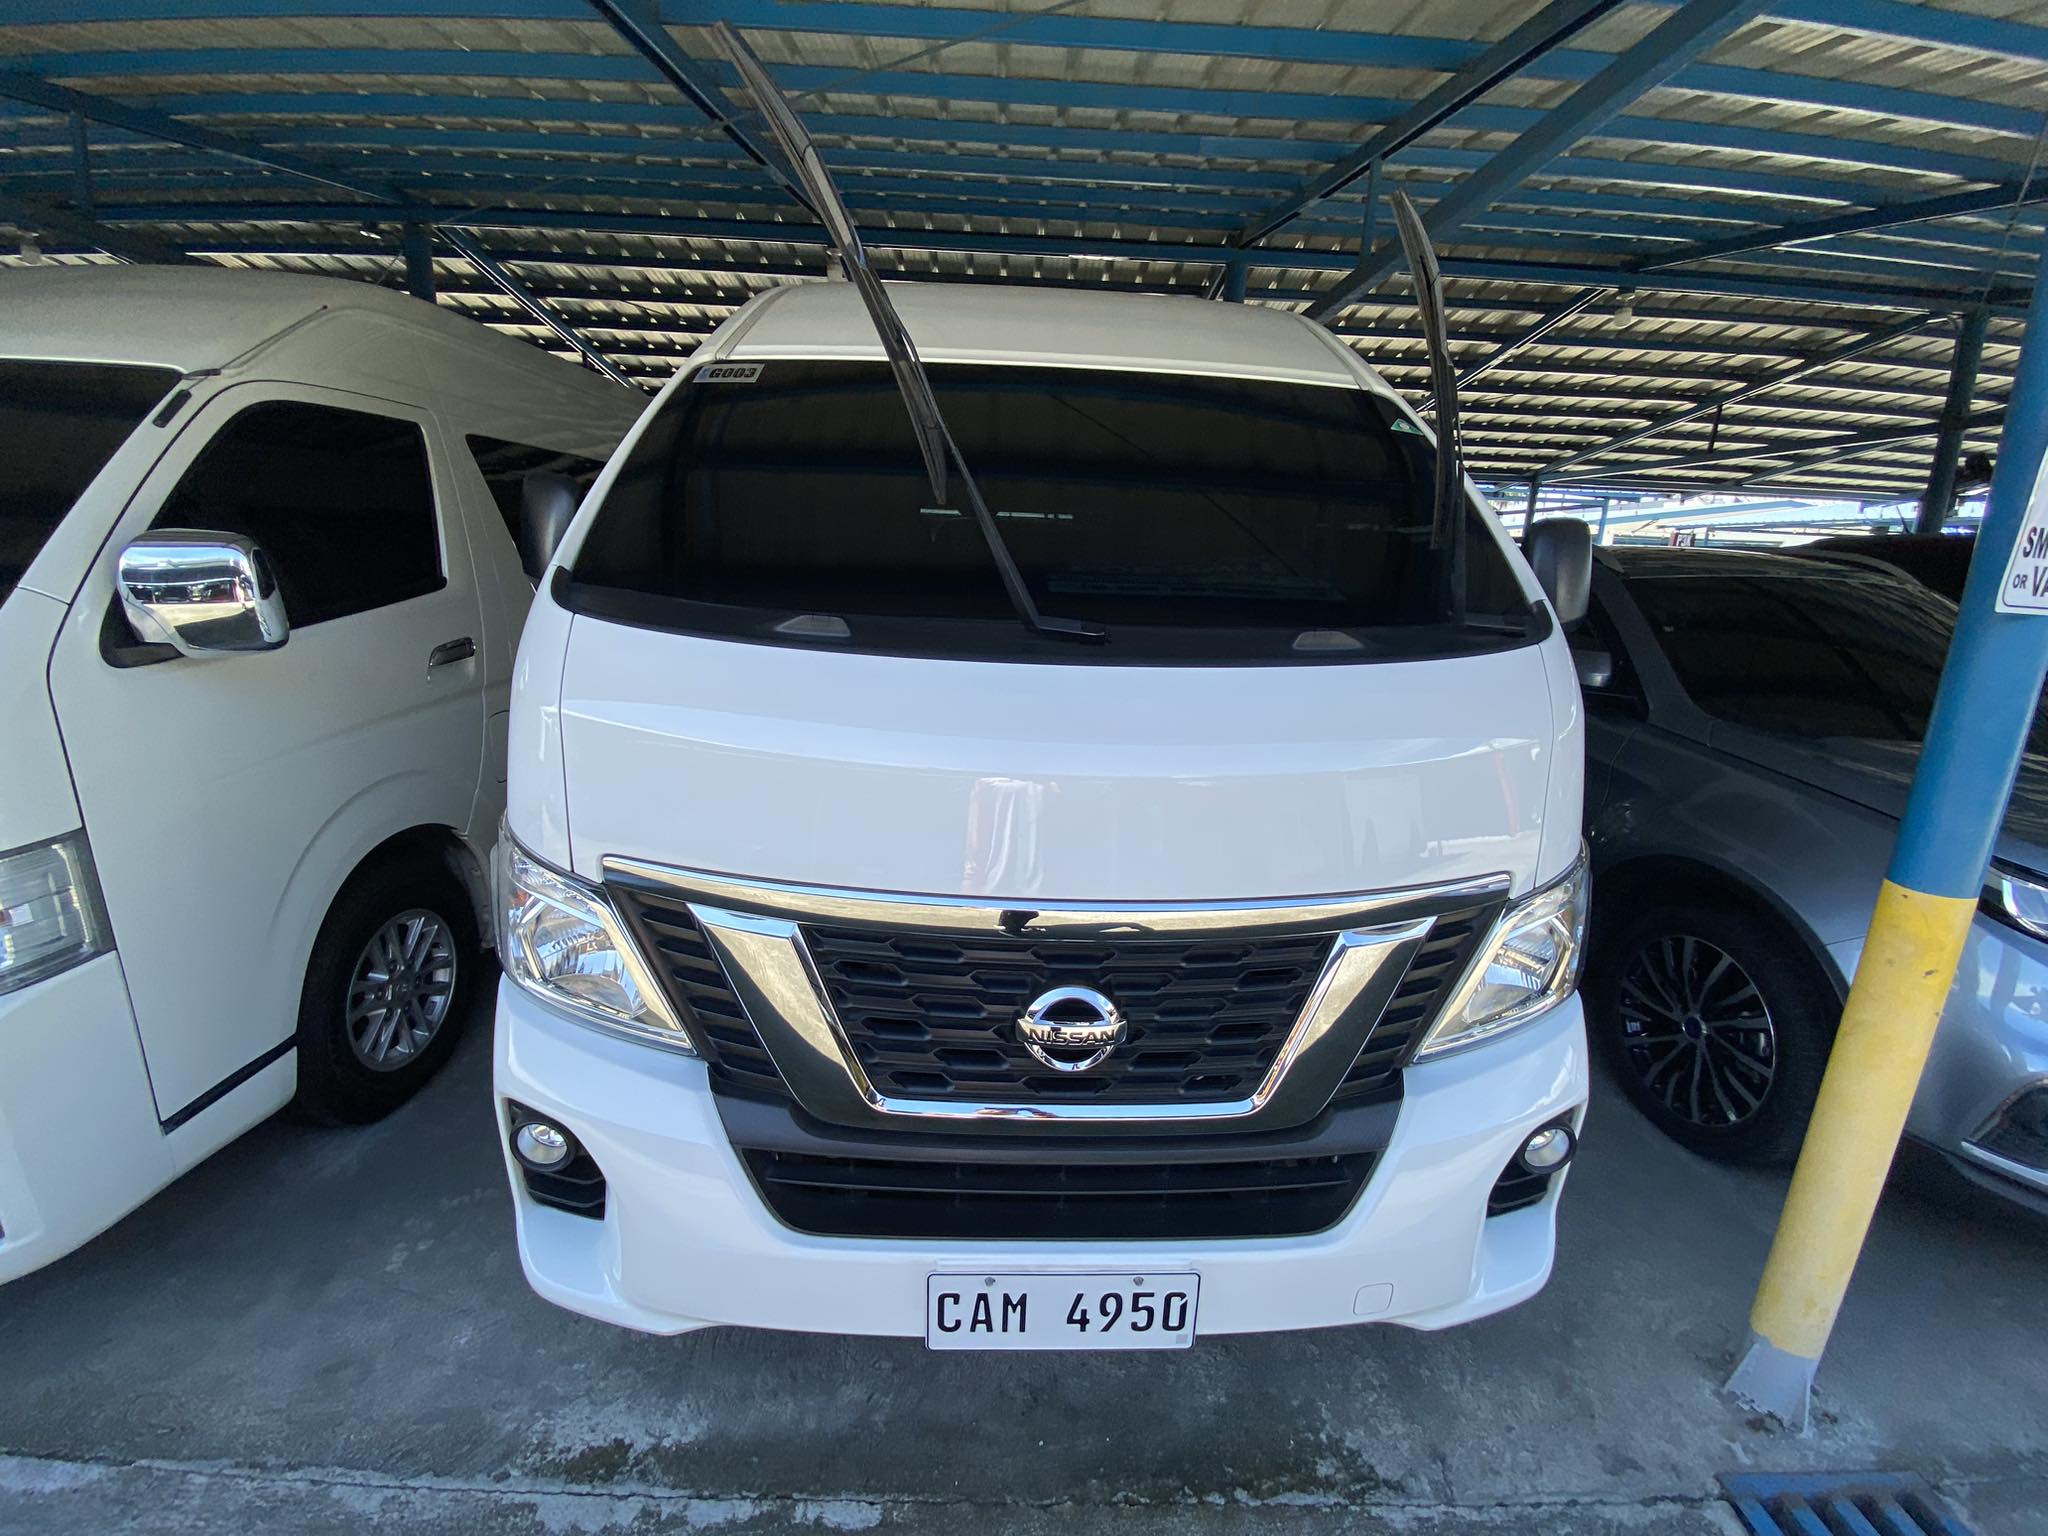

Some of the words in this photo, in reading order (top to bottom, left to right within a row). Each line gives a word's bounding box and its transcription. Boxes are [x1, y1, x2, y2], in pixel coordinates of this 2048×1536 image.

[2012, 574, 2028, 589] OR
[1028, 1029, 1115, 1045] NISSAN
[937, 1292, 1028, 1333] CAM
[1066, 1291, 1189, 1333] 4950
